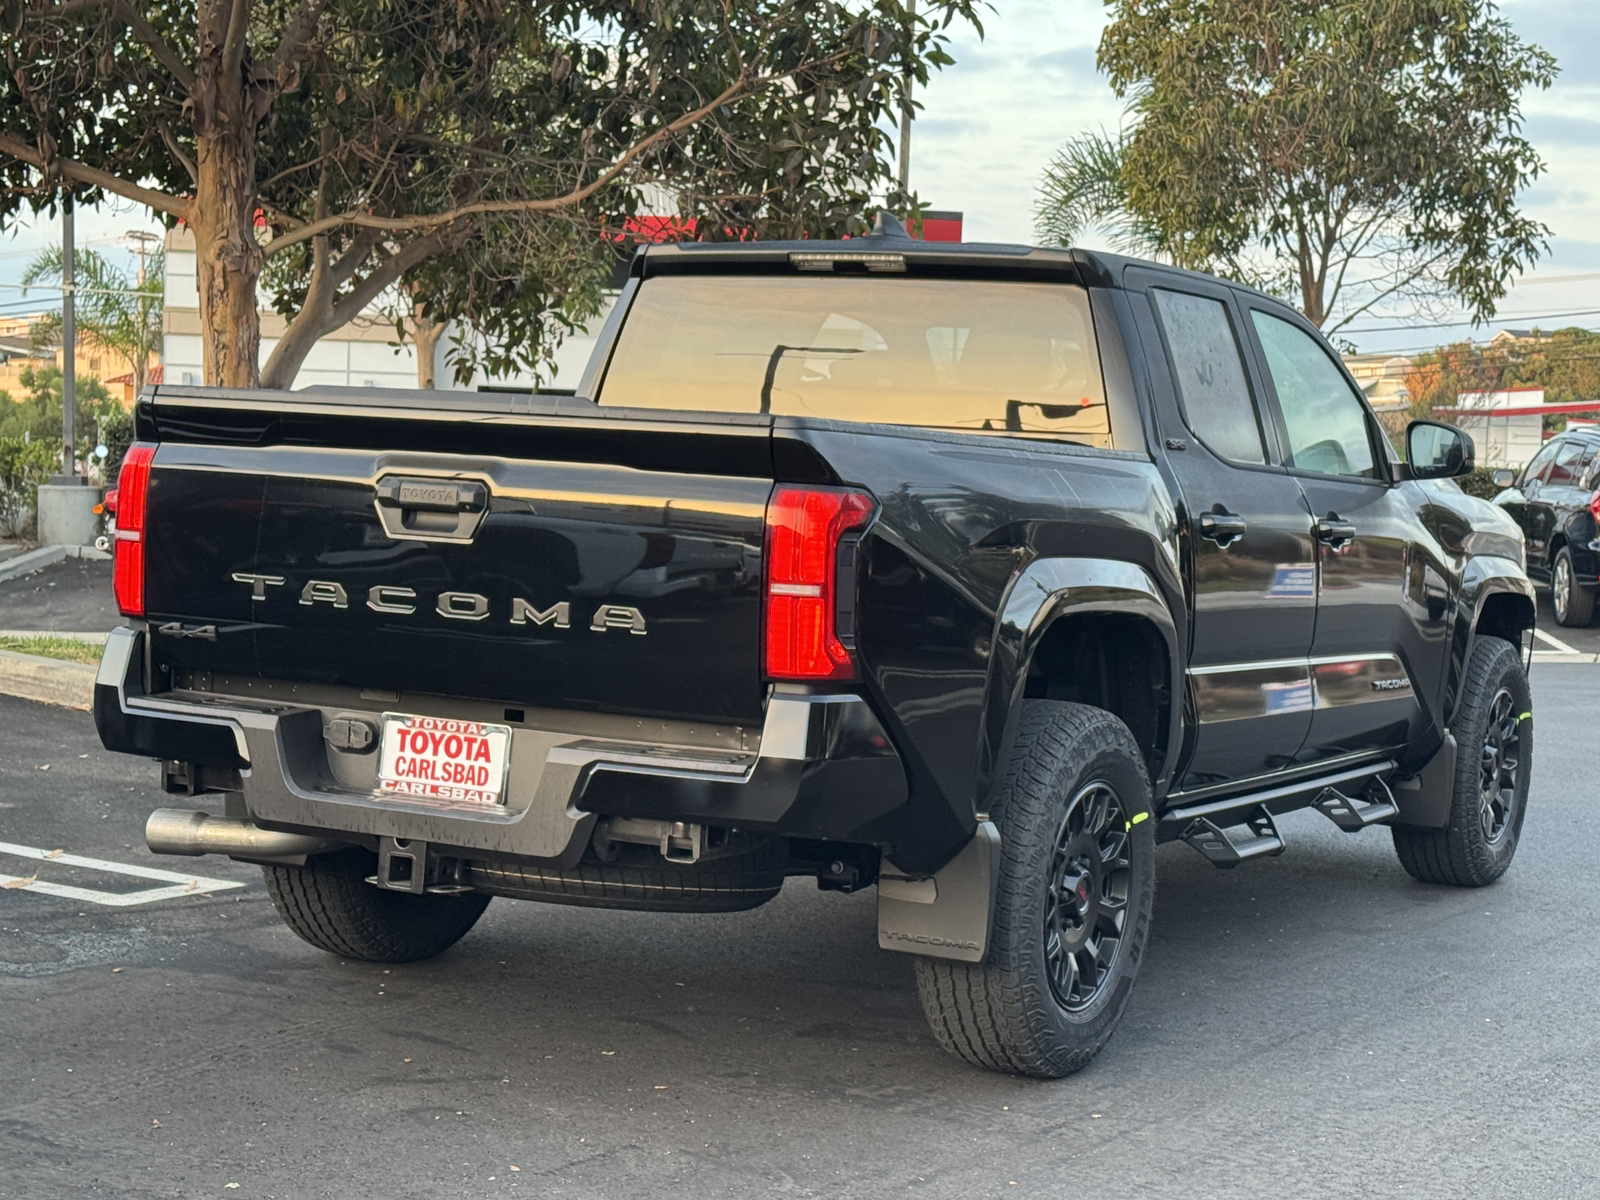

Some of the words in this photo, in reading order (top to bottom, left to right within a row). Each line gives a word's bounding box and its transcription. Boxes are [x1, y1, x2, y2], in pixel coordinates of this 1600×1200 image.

[401, 487, 454, 502] TOYOTA
[230, 572, 648, 636] TACOMA
[1371, 678, 1410, 691] TACOMA
[412, 717, 479, 735] TOYOTA
[397, 728, 491, 763] TOYOTA
[395, 756, 489, 787] CARLSBAD
[380, 779, 498, 804] CARLSBAD
[881, 929, 980, 951] TACOMA
